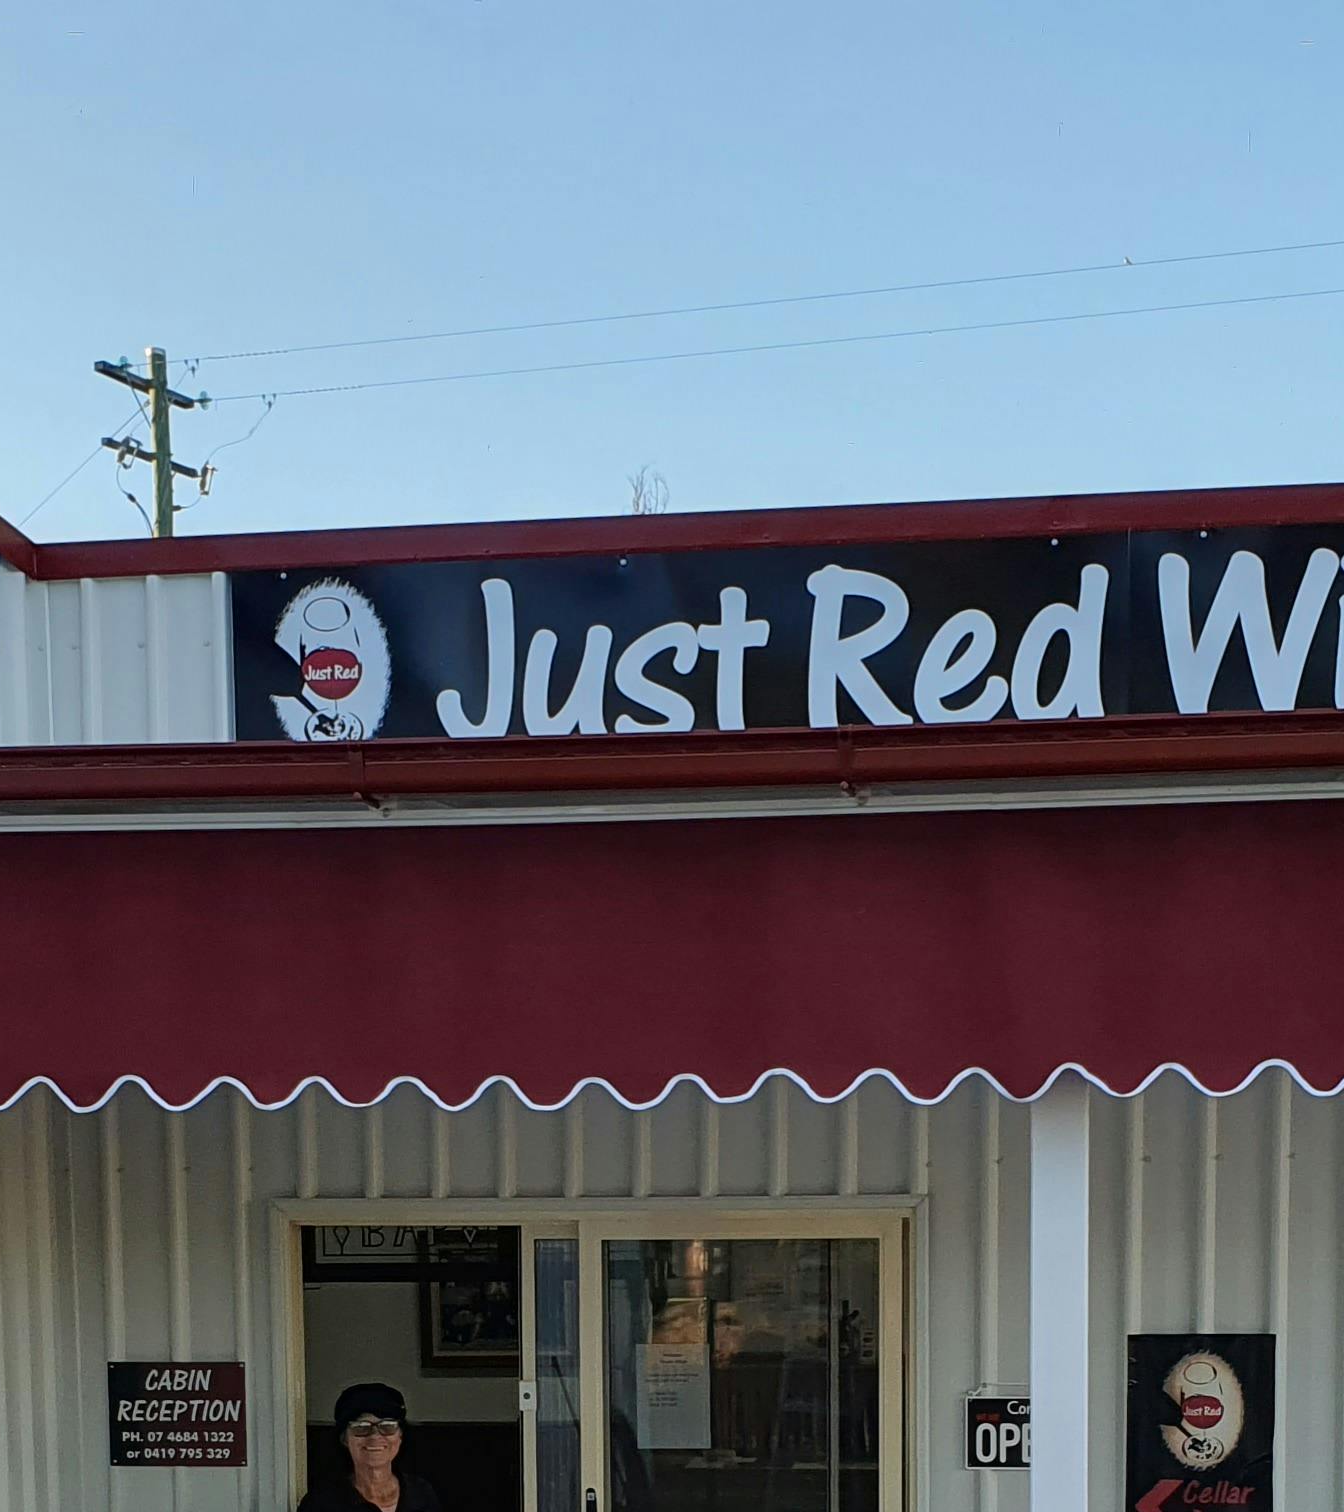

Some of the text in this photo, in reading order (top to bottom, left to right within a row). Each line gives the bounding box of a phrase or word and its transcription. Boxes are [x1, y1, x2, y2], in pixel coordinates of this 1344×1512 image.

[436, 578, 770, 738] Just
[806, 564, 1109, 729] Red
[303, 663, 359, 681] Just Red
[144, 1369, 212, 1391] CABIN
[117, 1399, 241, 1422] RECEPTION
[1183, 1405, 1203, 1416] Just
[122, 1431, 234, 1442] PH. 07 4684 1322
[126, 1448, 231, 1459] or 0419 795 329
[1182, 1479, 1256, 1505] Cellar
